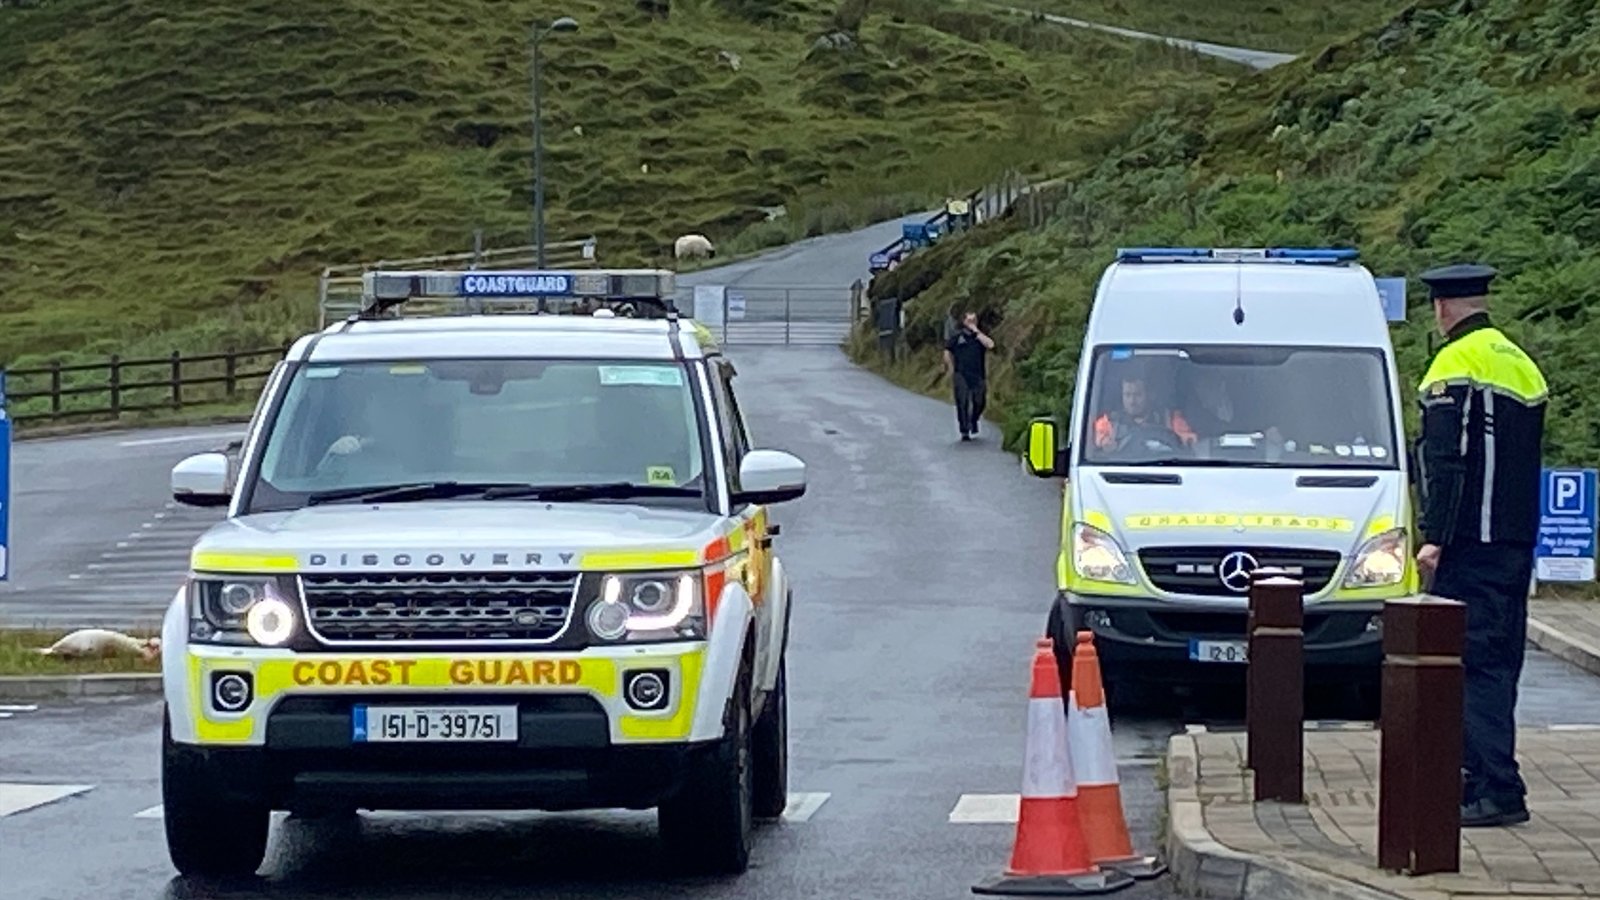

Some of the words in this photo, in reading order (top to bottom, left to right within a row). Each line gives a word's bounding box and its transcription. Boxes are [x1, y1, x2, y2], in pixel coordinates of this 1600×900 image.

[464, 276, 568, 293] COASTGUARD
[1557, 477, 1577, 507] P
[309, 554, 575, 566] DISCOVERY
[292, 660, 417, 685] COAST
[450, 660, 582, 685] GUARD
[382, 714, 501, 738] 151-D-39751
